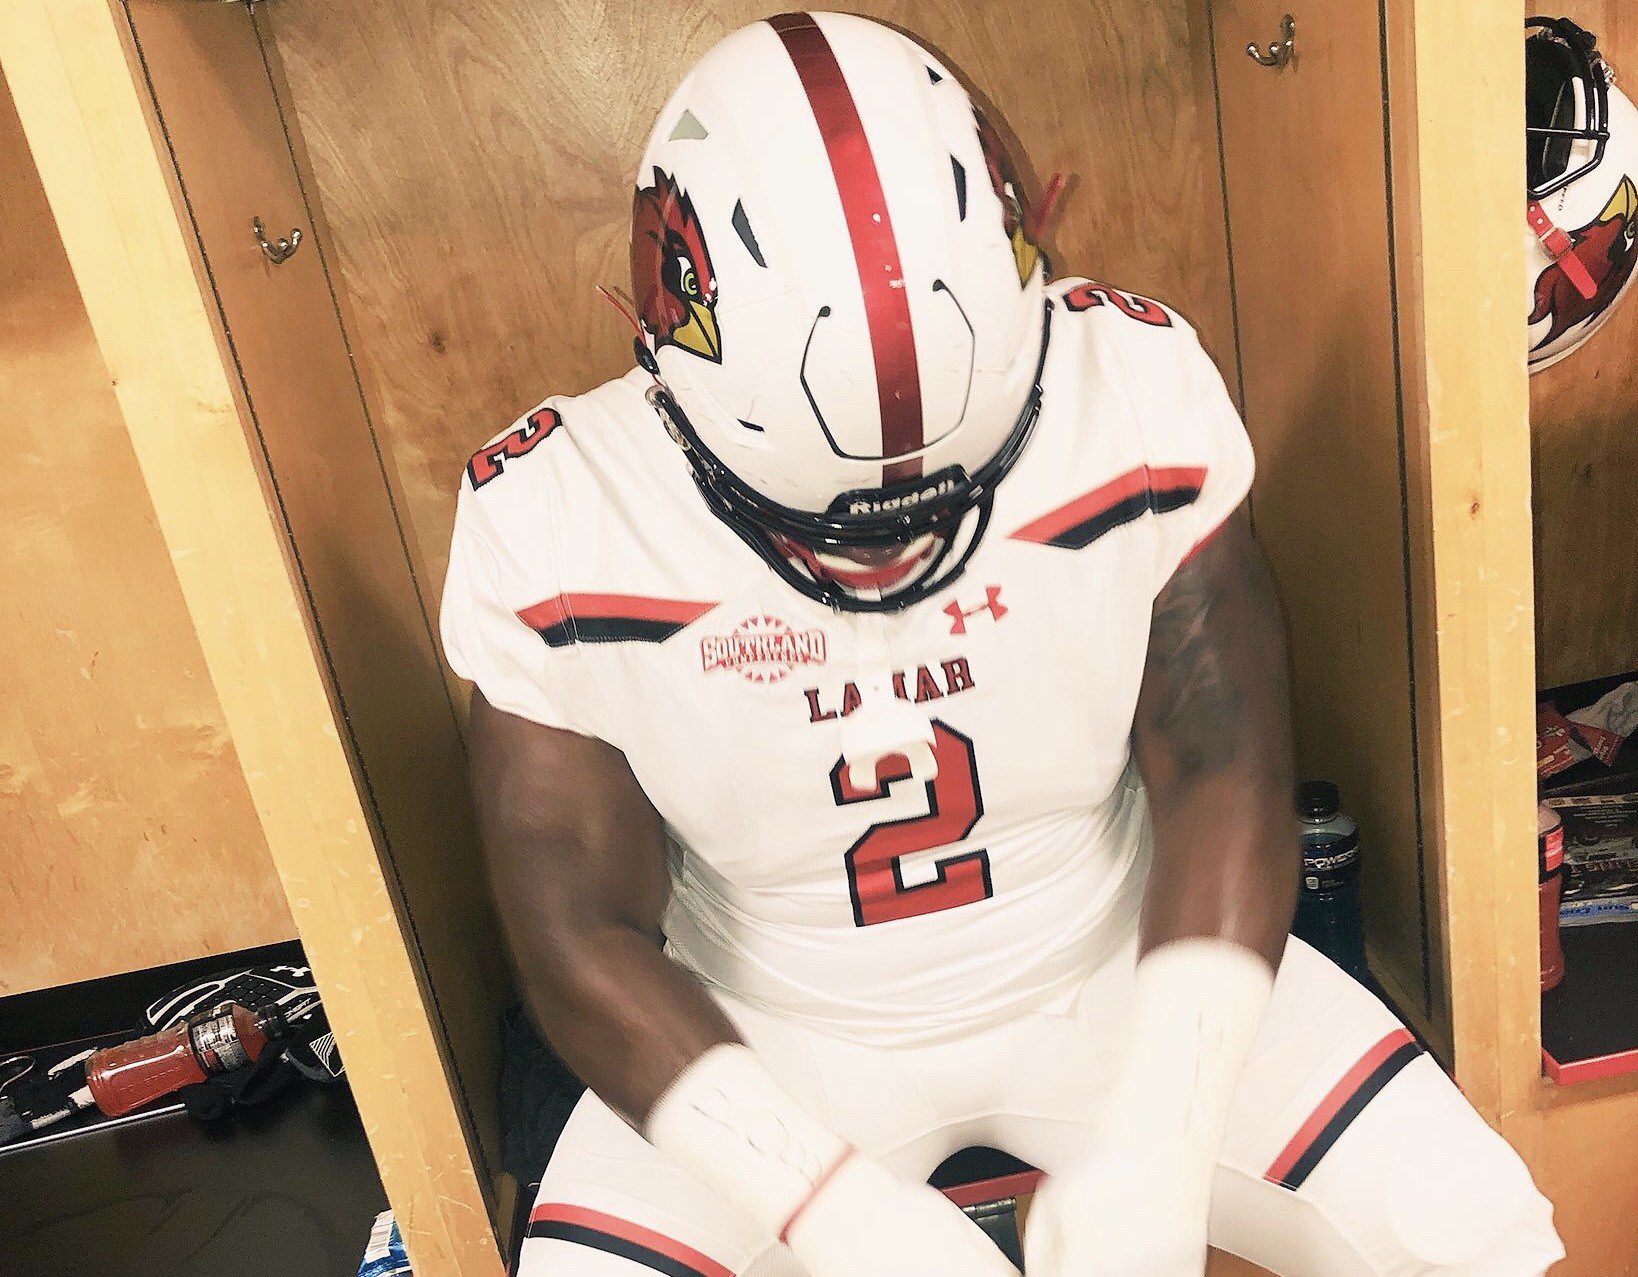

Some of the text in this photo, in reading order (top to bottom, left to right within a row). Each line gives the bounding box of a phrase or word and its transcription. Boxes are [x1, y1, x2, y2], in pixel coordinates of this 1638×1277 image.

[466, 408, 562, 491] 2
[850, 479, 955, 515] Riddell
[701, 631, 827, 670] SOUTHLAND
[829, 717, 993, 927] 2
